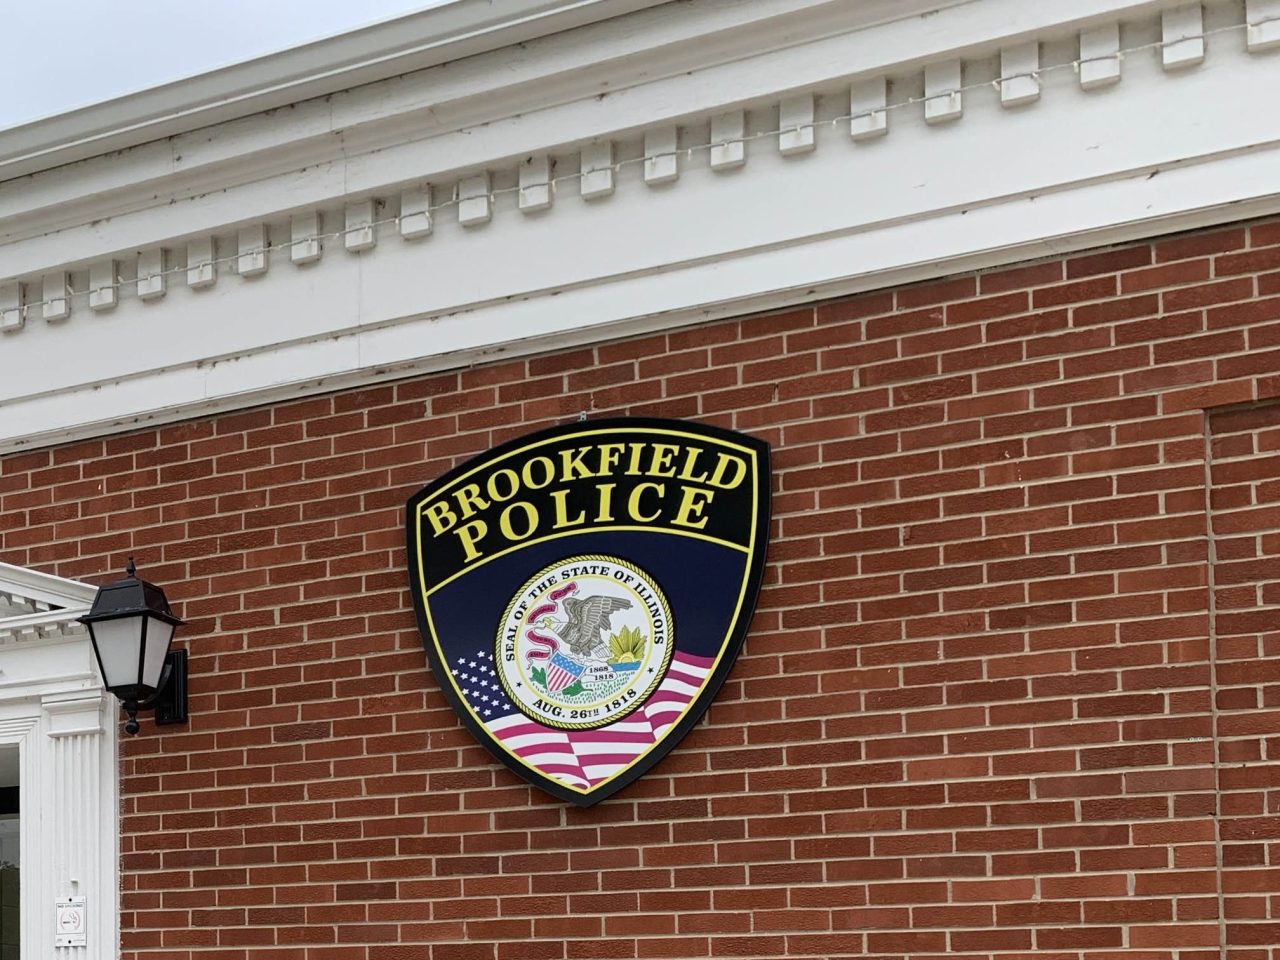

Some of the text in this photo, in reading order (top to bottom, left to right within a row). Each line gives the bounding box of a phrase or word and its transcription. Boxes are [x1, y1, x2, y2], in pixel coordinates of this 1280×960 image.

[422, 442, 747, 538] BROOKFIELD
[453, 482, 716, 563] POLICE
[505, 625, 518, 662] SEAL
[514, 600, 529, 620] OF
[528, 575, 558, 600] THE
[561, 565, 610, 580] STATE
[614, 570, 634, 584] OF
[633, 582, 664, 645] ILLINOIS
[589, 666, 609, 674] 1868
[594, 673, 614, 681] 1818
[533, 688, 637, 719] AUG. 26TH 1818
